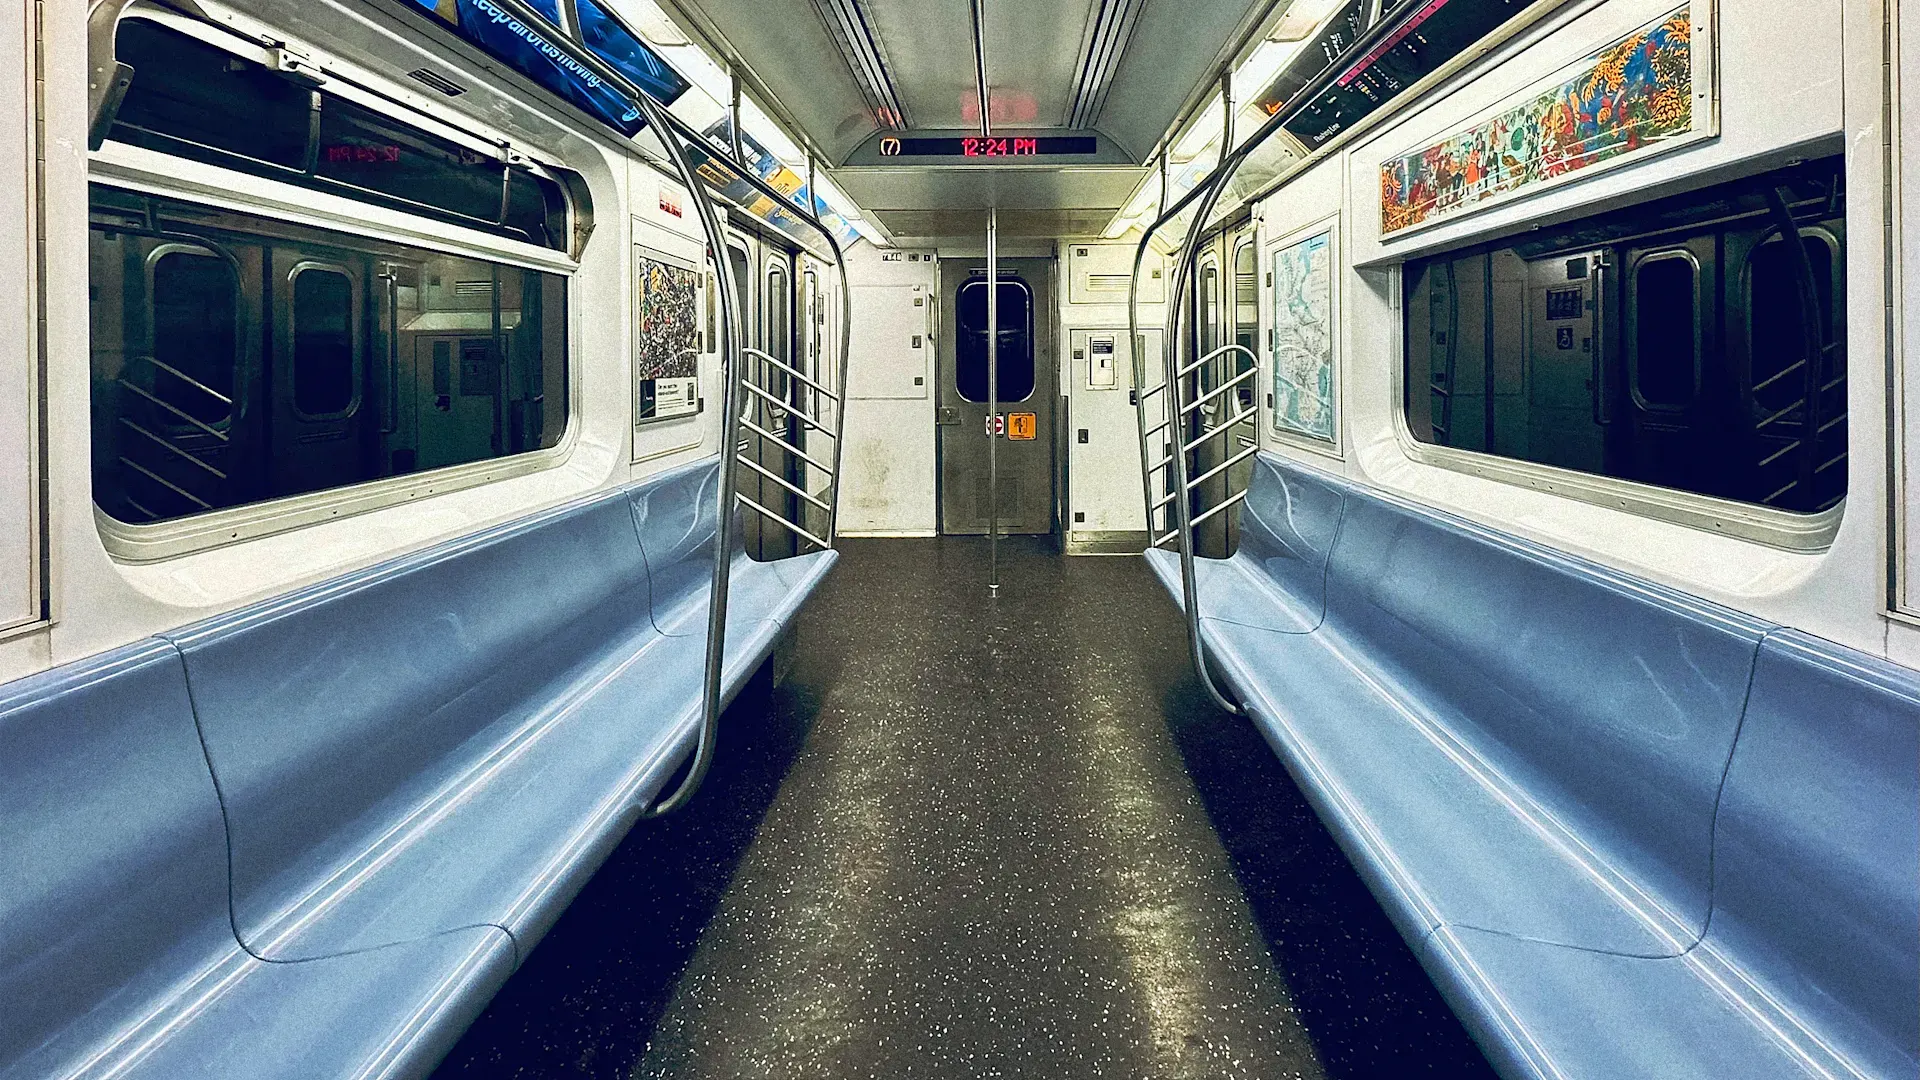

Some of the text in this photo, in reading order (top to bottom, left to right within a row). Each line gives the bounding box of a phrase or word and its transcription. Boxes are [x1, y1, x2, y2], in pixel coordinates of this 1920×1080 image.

[880, 138, 1036, 156] (7) 12:24 PM
